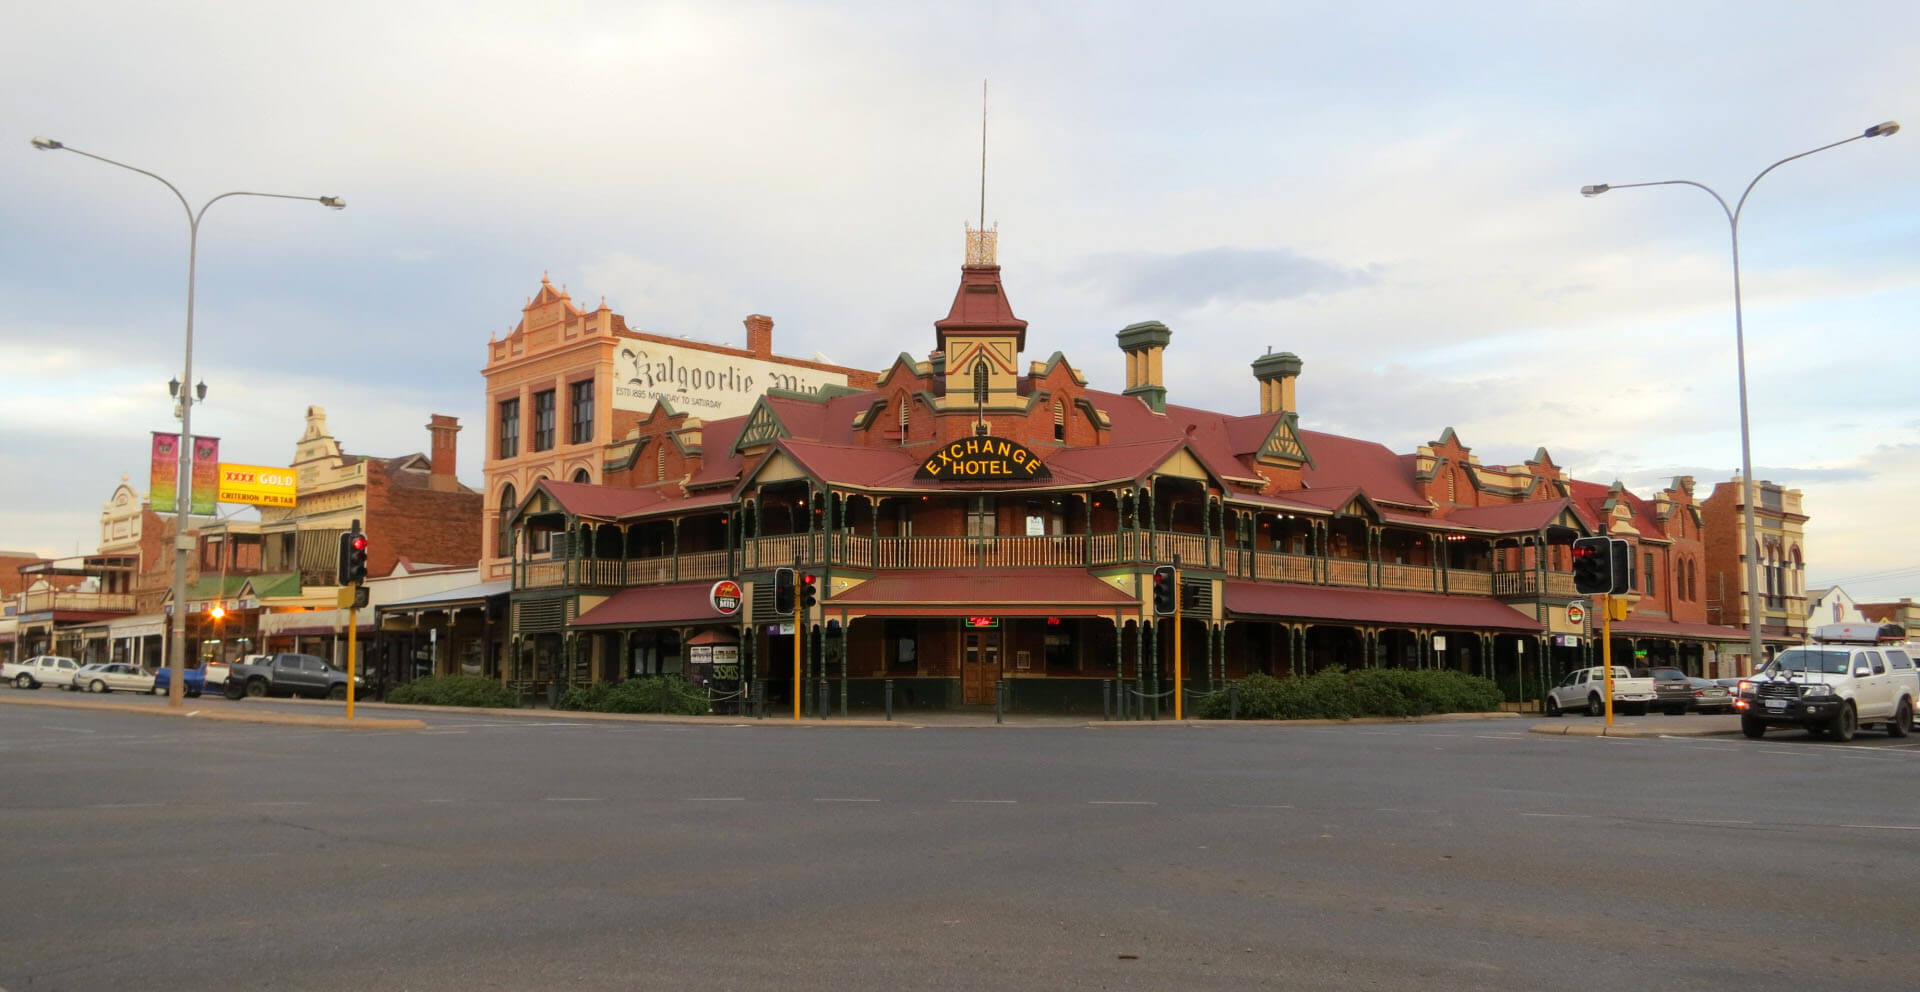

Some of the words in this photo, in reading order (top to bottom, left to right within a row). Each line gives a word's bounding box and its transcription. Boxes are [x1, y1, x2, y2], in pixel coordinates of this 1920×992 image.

[621, 348, 754, 393] Kalgoorlie
[682, 395, 690, 405] TO
[691, 397, 722, 409] SATURDAY
[925, 439, 1041, 475] EXCHANGE
[952, 460, 1013, 475] HOTEL
[226, 471, 255, 482] XXXX
[260, 473, 293, 487] GOLD
[221, 492, 260, 502] CRITERION
[719, 600, 735, 609] MID
